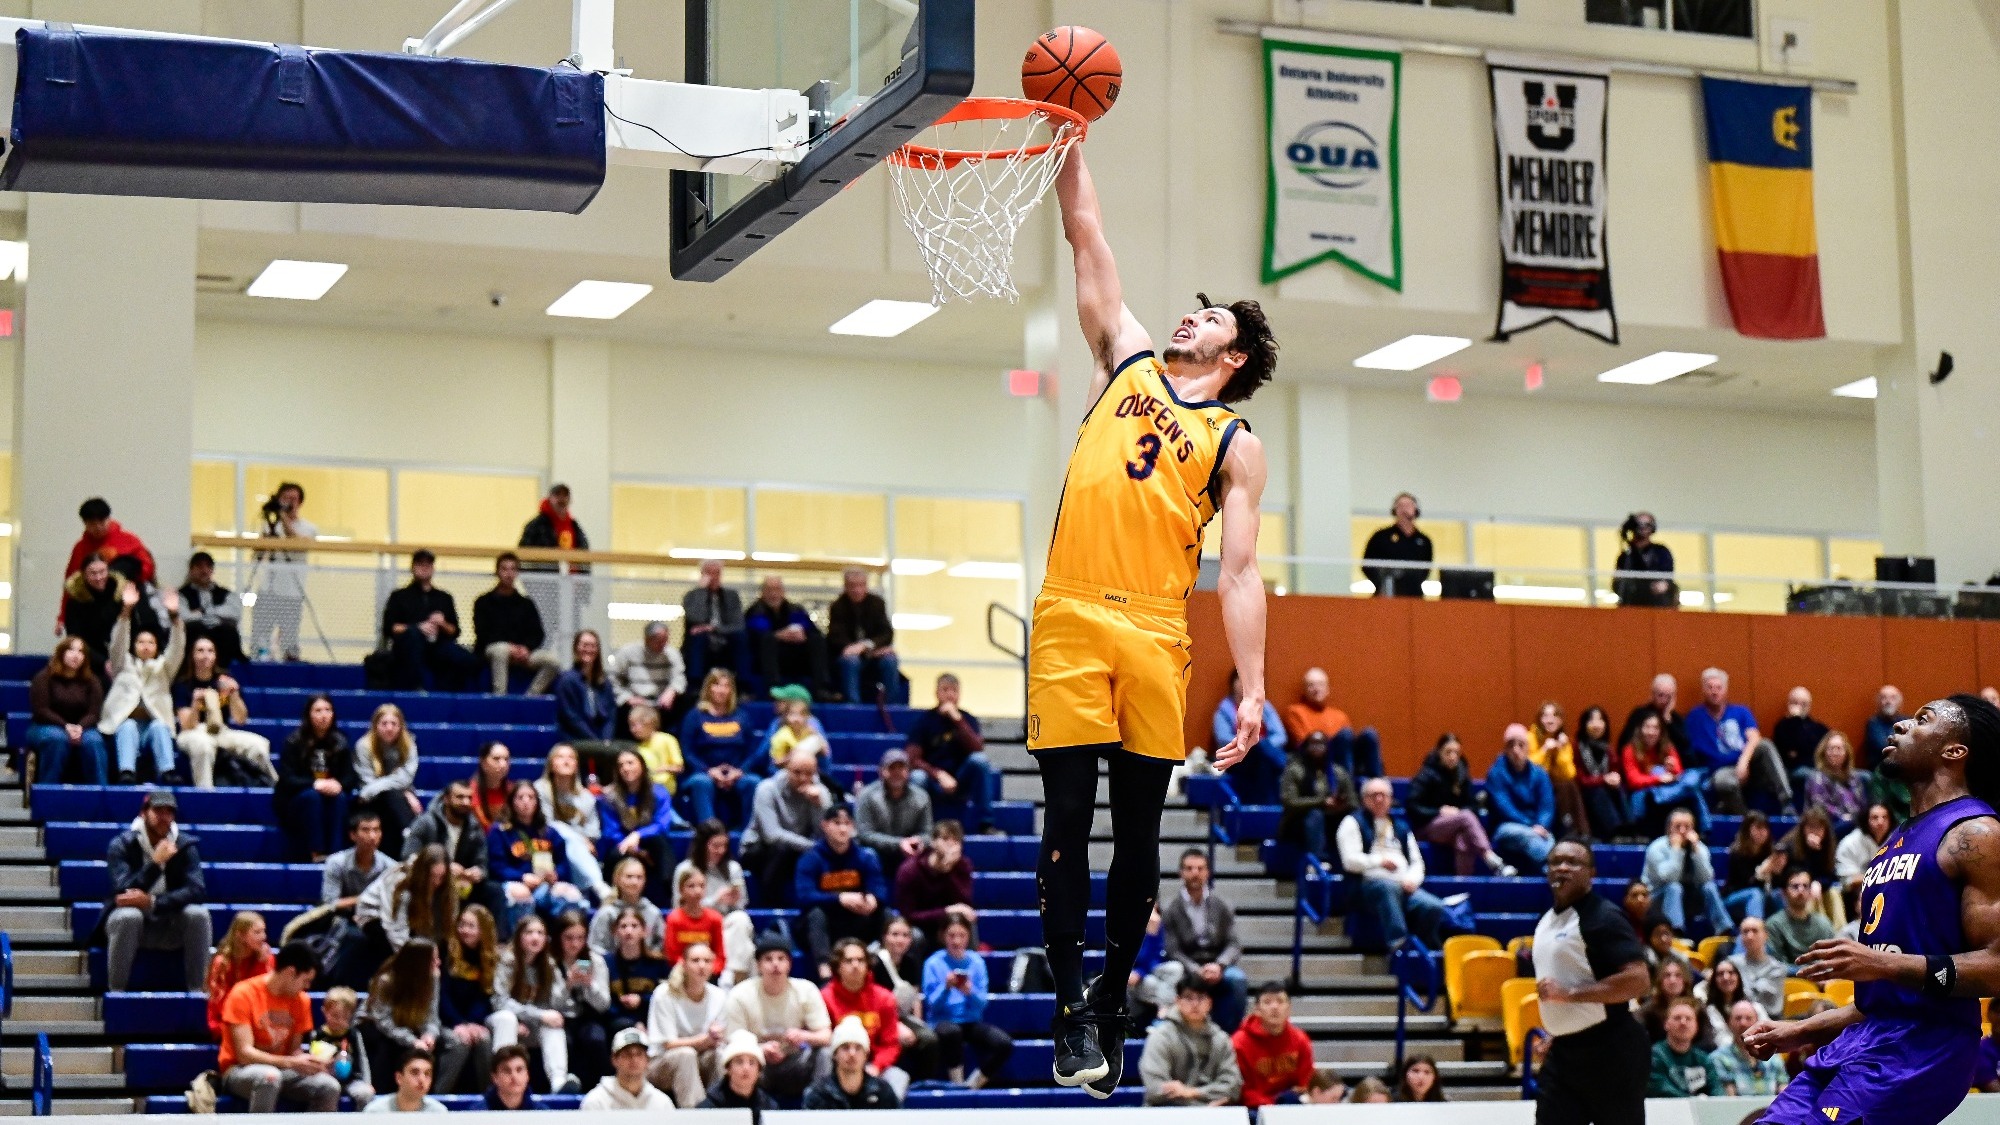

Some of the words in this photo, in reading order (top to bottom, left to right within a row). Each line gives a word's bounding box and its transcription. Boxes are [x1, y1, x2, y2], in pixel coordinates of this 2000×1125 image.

[1287, 142, 1379, 170] OUA
[1508, 154, 1593, 207] MEMBER
[1512, 209, 1596, 259] MEMBRE
[1115, 393, 1194, 463] QUEEN'S
[1126, 433, 1162, 482] 3
[1105, 593, 1127, 604] GAELS
[1862, 853, 1921, 893] GOLDEN
